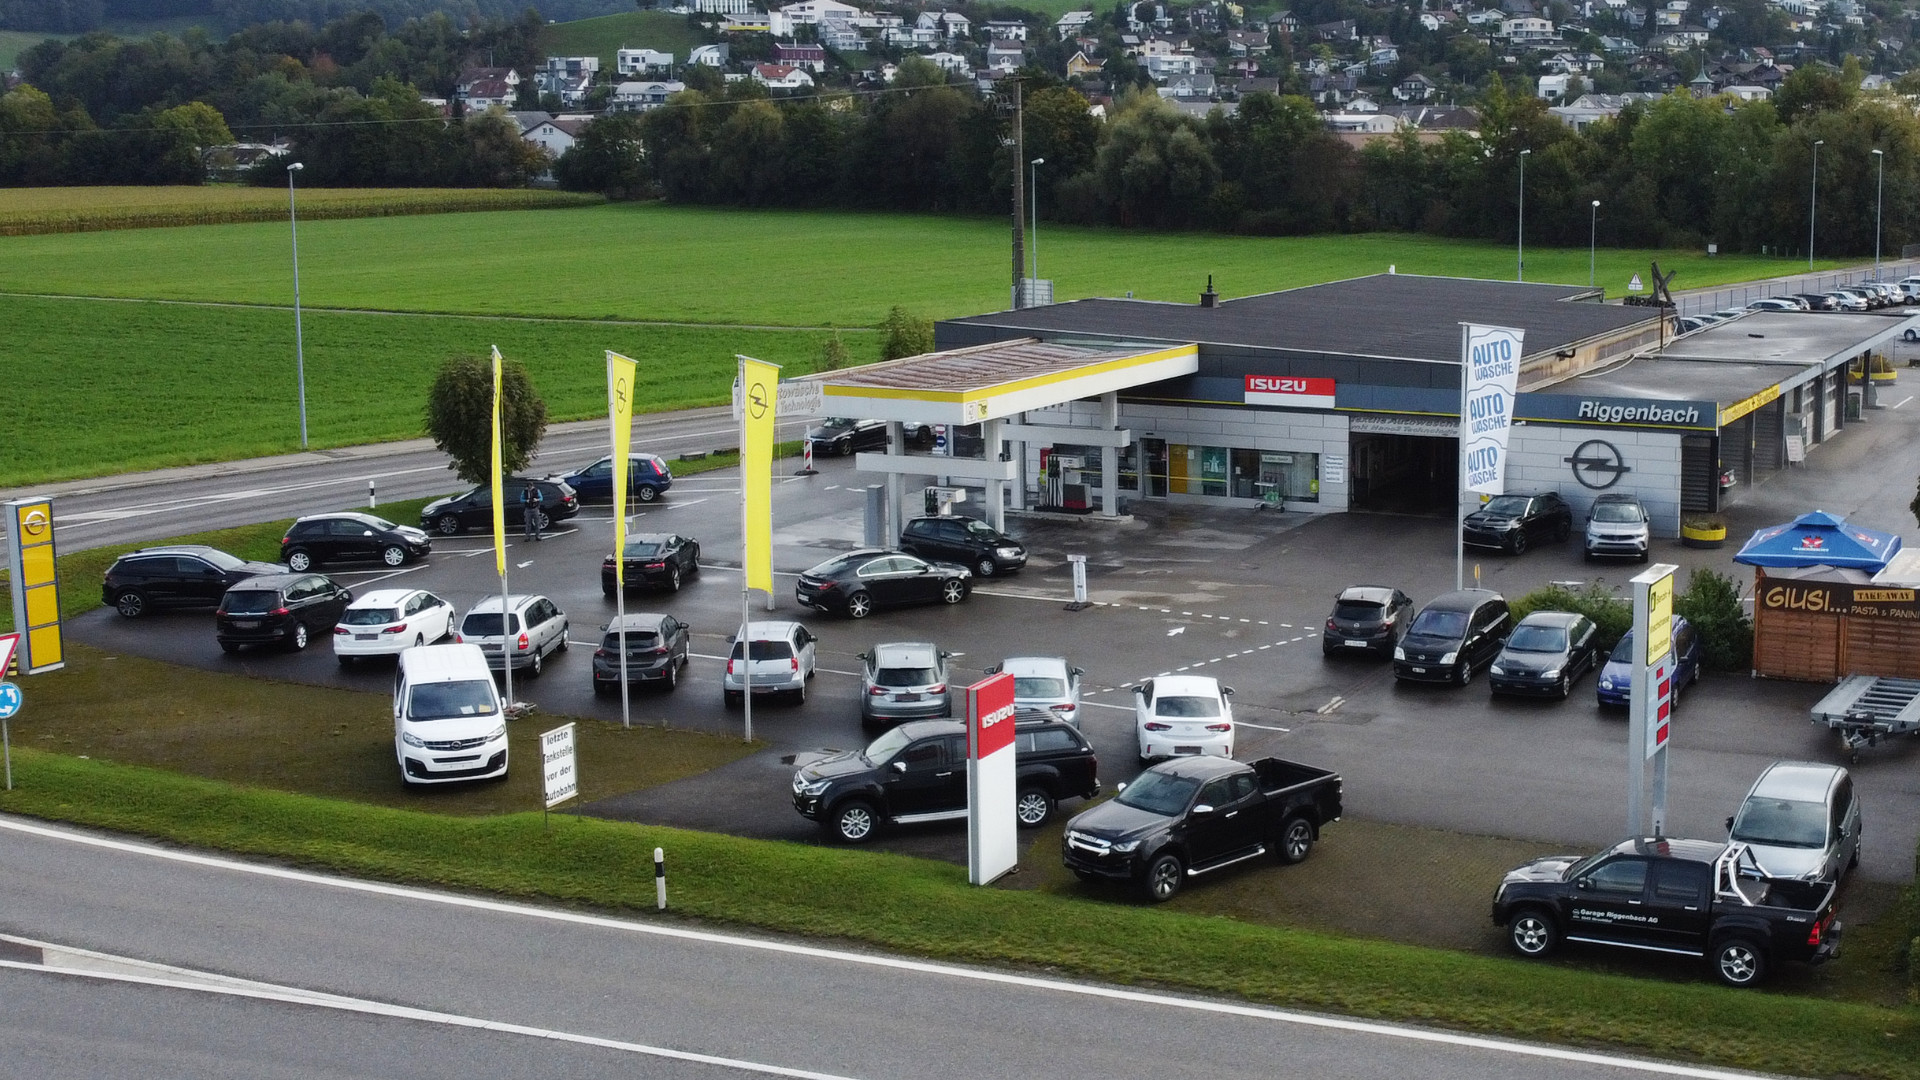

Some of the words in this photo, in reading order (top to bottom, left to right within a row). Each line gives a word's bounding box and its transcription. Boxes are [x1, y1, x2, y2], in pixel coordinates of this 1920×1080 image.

[1472, 339, 1512, 367] AUTO
[1474, 361, 1514, 381] WÄSCHE
[1250, 378, 1306, 392] ISUZU
[1470, 393, 1505, 421] AUTO
[1578, 401, 1699, 423] Riggenbach
[1467, 446, 1498, 474] AUTO
[1857, 592, 1911, 600] TAKE-AWAY
[1851, 605, 1878, 616] PASTA
[1890, 608, 1920, 619] PANINI
[982, 703, 1015, 728] ISUZU
[547, 731, 568, 746] letzte
[546, 771, 558, 781] vor
[560, 765, 571, 776] der
[1580, 909, 1605, 918] Garage
[1606, 911, 1647, 922] Riggenbach
